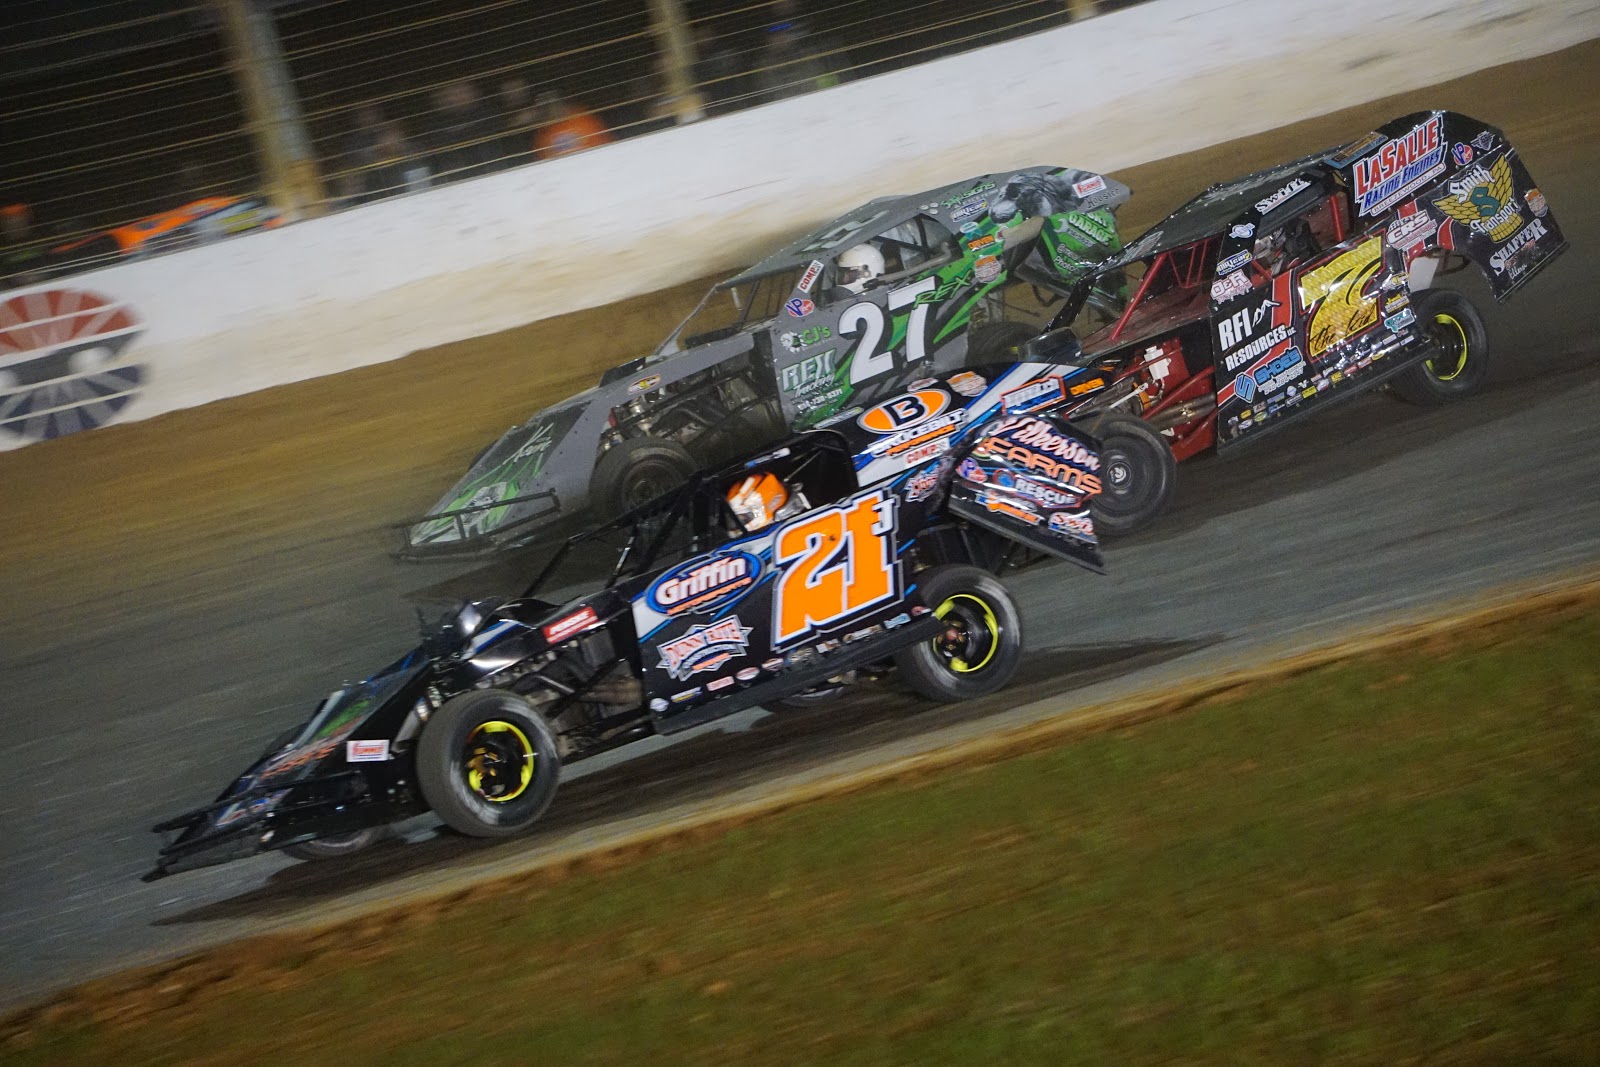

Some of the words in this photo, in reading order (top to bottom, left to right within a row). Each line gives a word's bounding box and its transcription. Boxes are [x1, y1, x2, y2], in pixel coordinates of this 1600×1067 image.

[1363, 180, 1401, 209] RACING
[1402, 147, 1441, 184] ENGINES
[1450, 164, 1495, 204] Smith
[1069, 213, 1112, 245] GARAGE
[1387, 213, 1429, 244] CRS
[1470, 196, 1521, 234] Transport
[1490, 218, 1548, 276] SHAFFER
[838, 276, 936, 386] 27
[1218, 307, 1252, 351] RFI
[1225, 324, 1288, 371] RESOURCES
[882, 396, 925, 427] B
[986, 437, 1103, 494] FARMS
[1015, 478, 1077, 505] RESCUE
[655, 556, 746, 605] Griffin
[774, 490, 895, 645] 21
